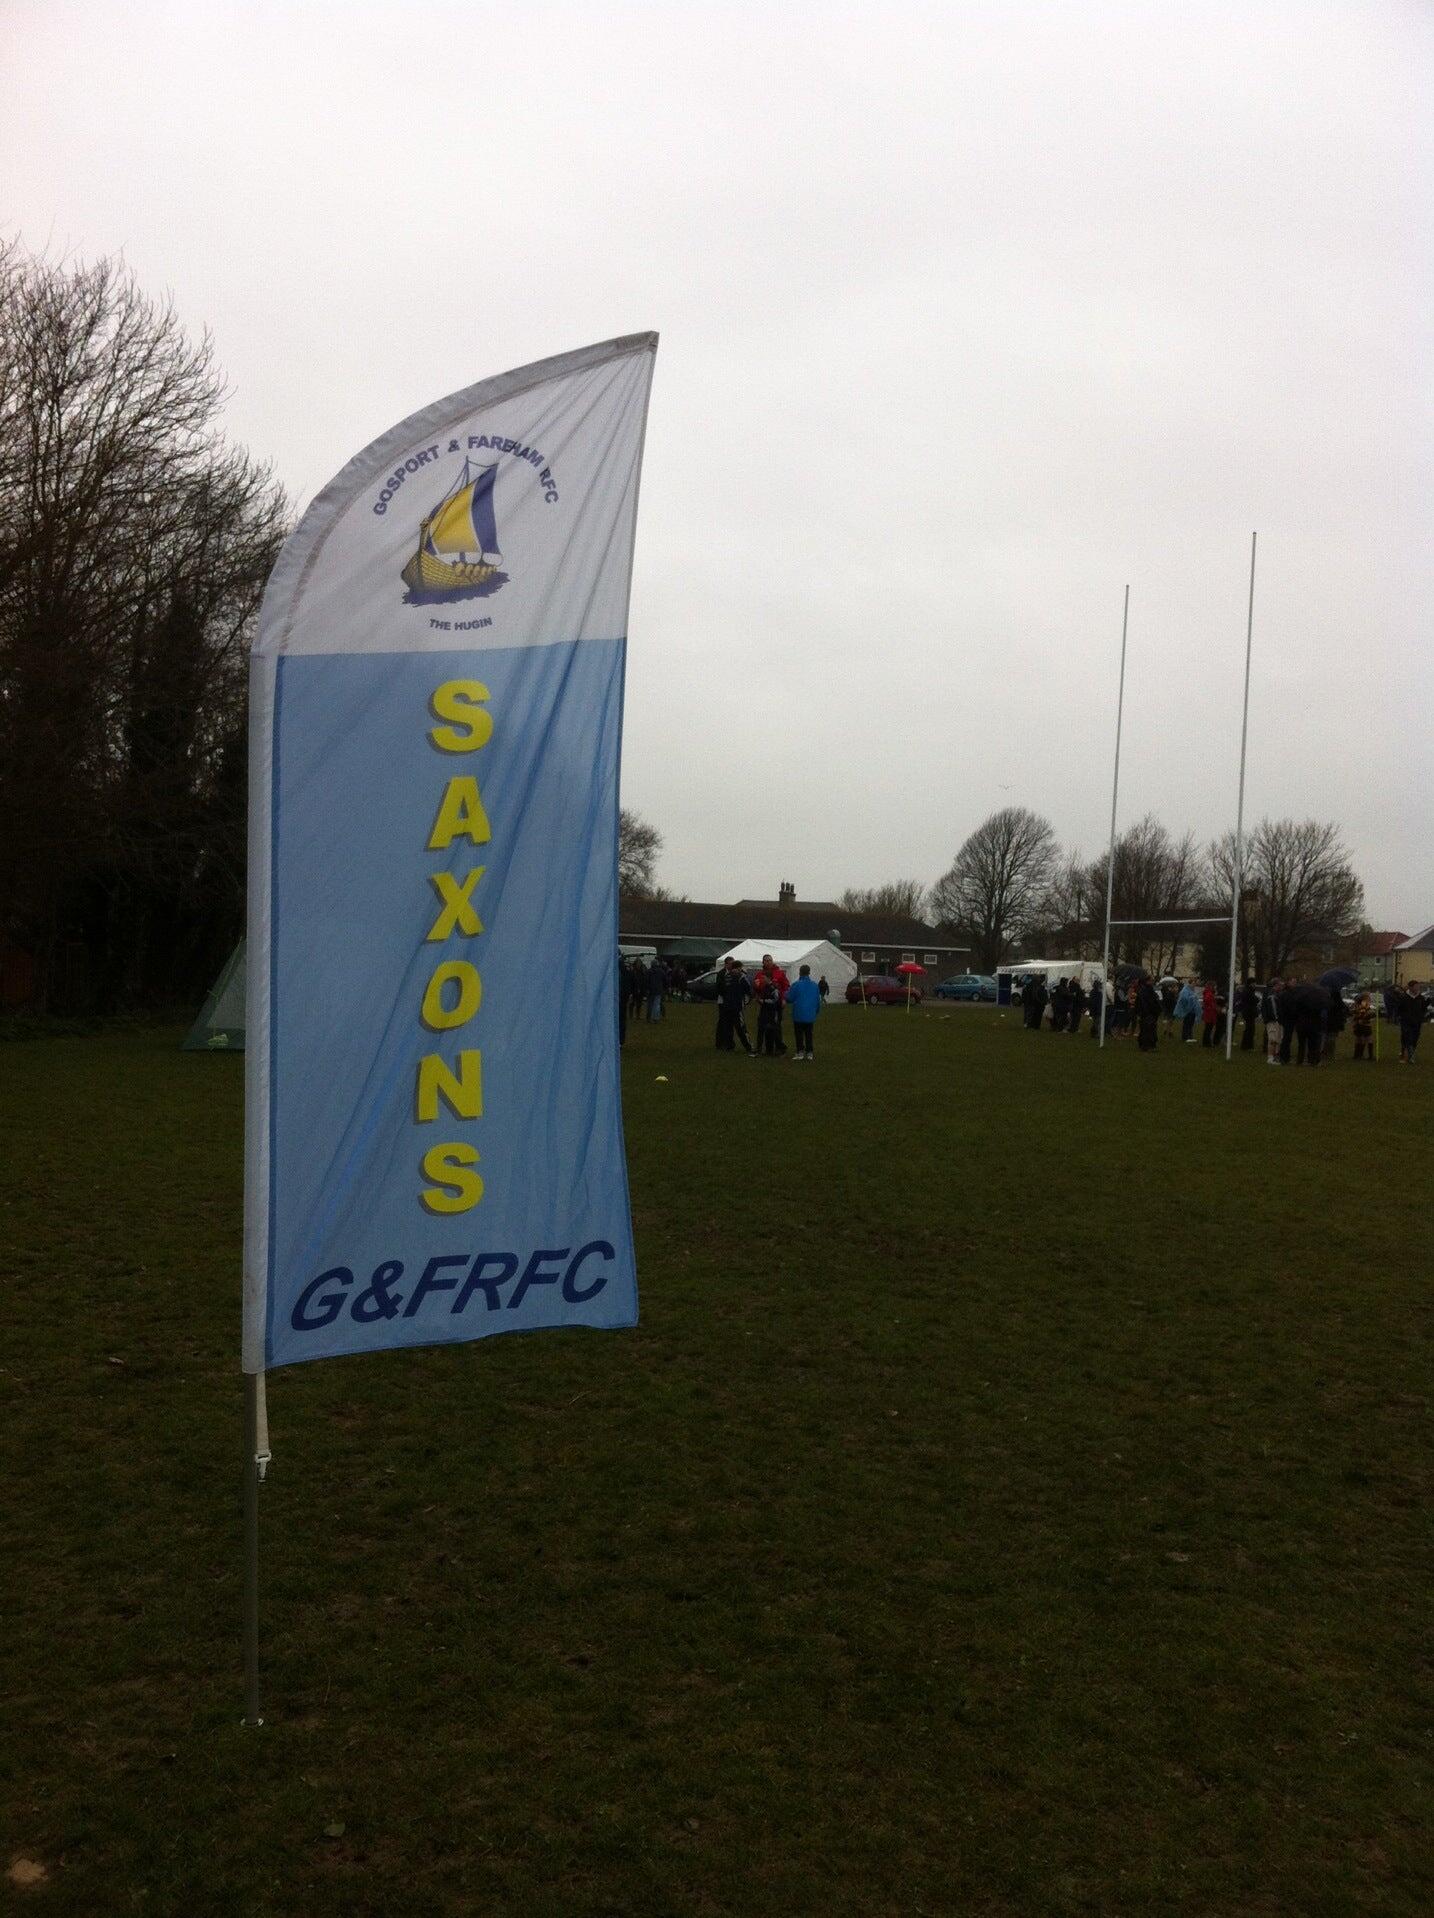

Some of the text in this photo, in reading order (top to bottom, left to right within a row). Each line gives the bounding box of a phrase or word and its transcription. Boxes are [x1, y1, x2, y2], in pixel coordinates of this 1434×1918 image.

[373, 435, 560, 516] GOSPORT & FAREHAM RFC
[429, 617, 493, 631] THE HUGIN
[414, 679, 494, 1217] SAXONS
[290, 1240, 615, 1332] G&FRFC
